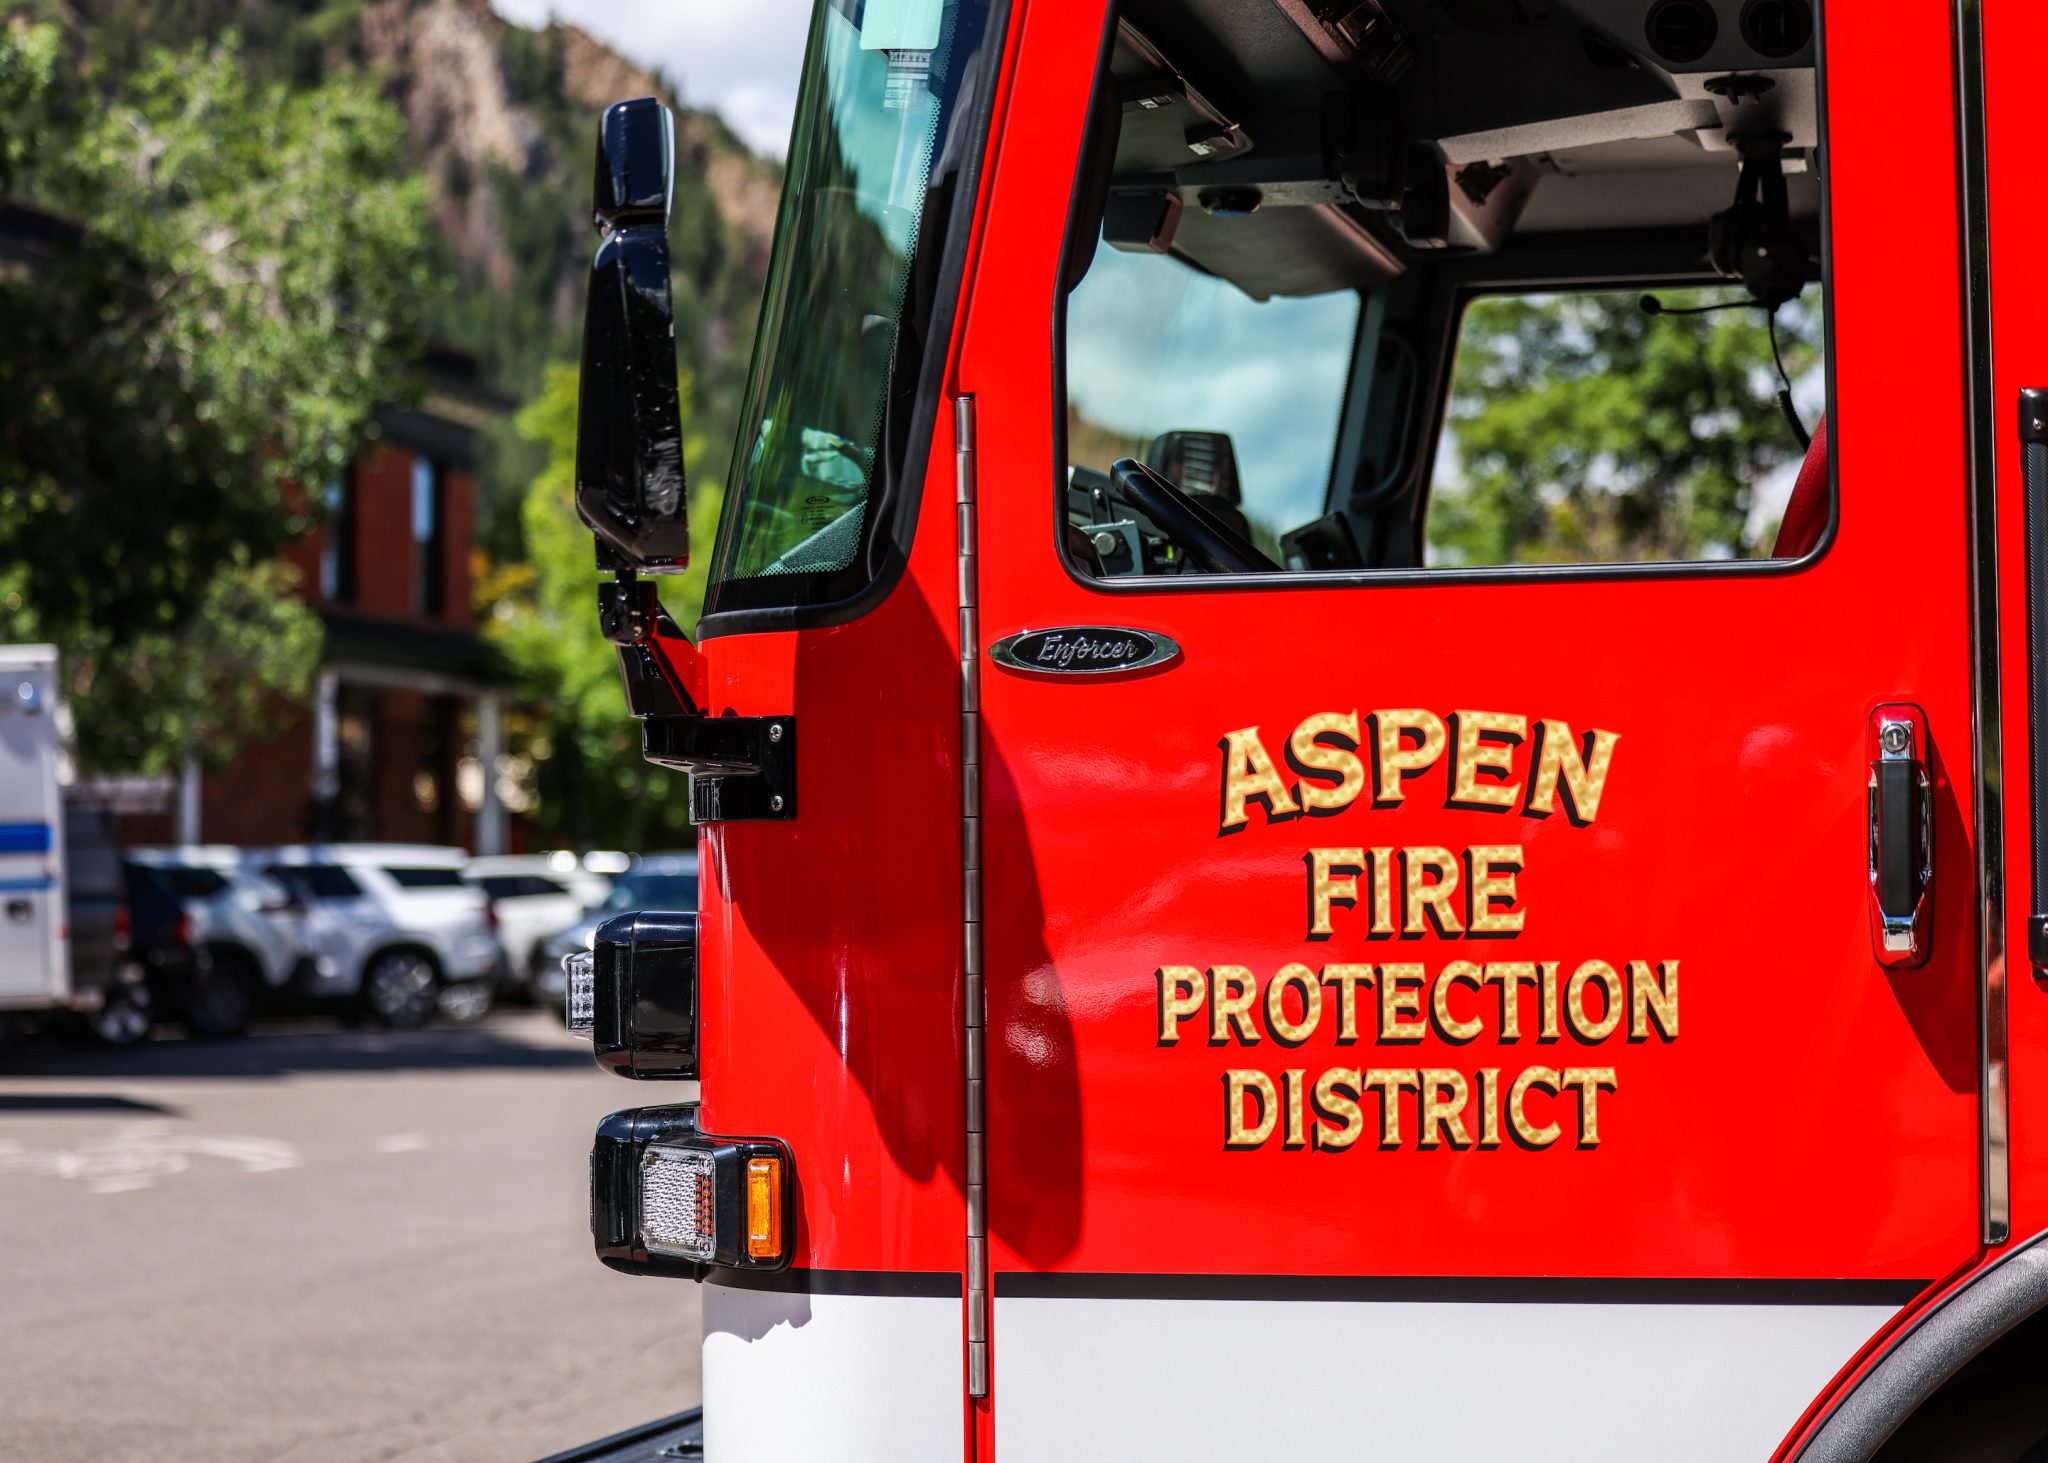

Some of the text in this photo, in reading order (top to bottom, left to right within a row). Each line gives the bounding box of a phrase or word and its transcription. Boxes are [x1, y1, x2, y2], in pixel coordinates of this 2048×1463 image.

[1037, 635, 1139, 667] Enforcer
[1217, 708, 1621, 837] ASPEN
[1303, 844, 1526, 941] FIRE
[1154, 960, 1680, 1047] PROTECTION
[1221, 1065, 1618, 1153] DISTRICT
